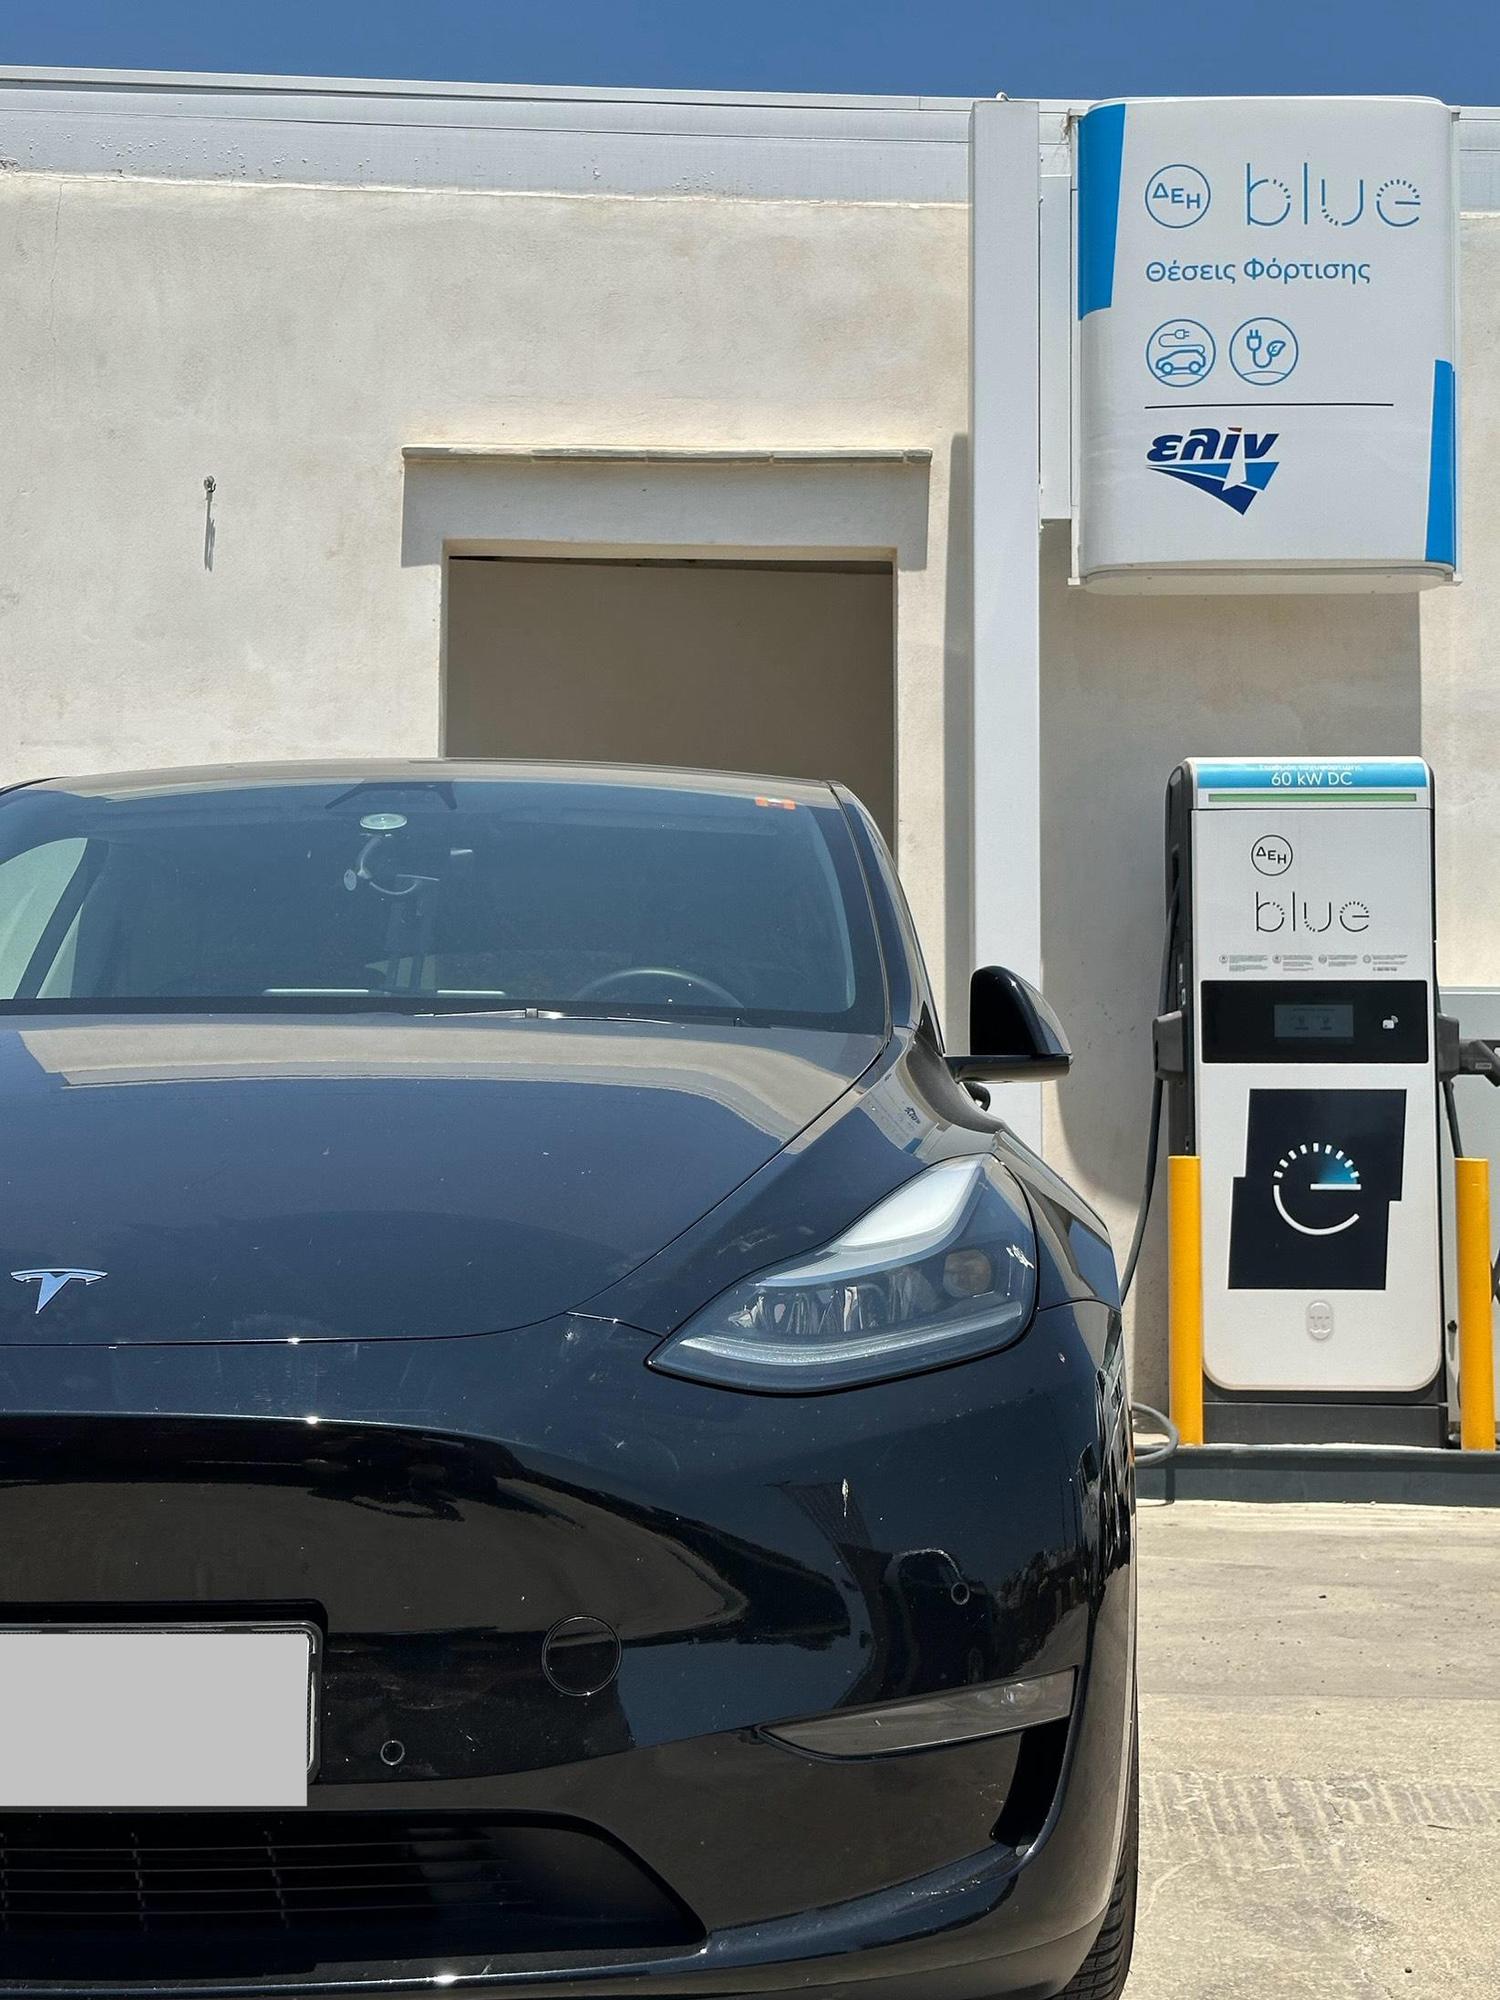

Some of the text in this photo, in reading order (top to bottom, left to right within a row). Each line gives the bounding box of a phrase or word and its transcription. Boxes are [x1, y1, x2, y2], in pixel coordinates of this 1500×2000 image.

[1152, 182, 1201, 210] ΔΕΗ
[1246, 162, 1421, 227] blue
[1146, 257, 1371, 285] Θέσεις Φόρτισης
[1271, 771, 1353, 786] 60 kW DC
[1256, 846, 1287, 865] ΔΕΗ
[1255, 891, 1370, 933] blue
